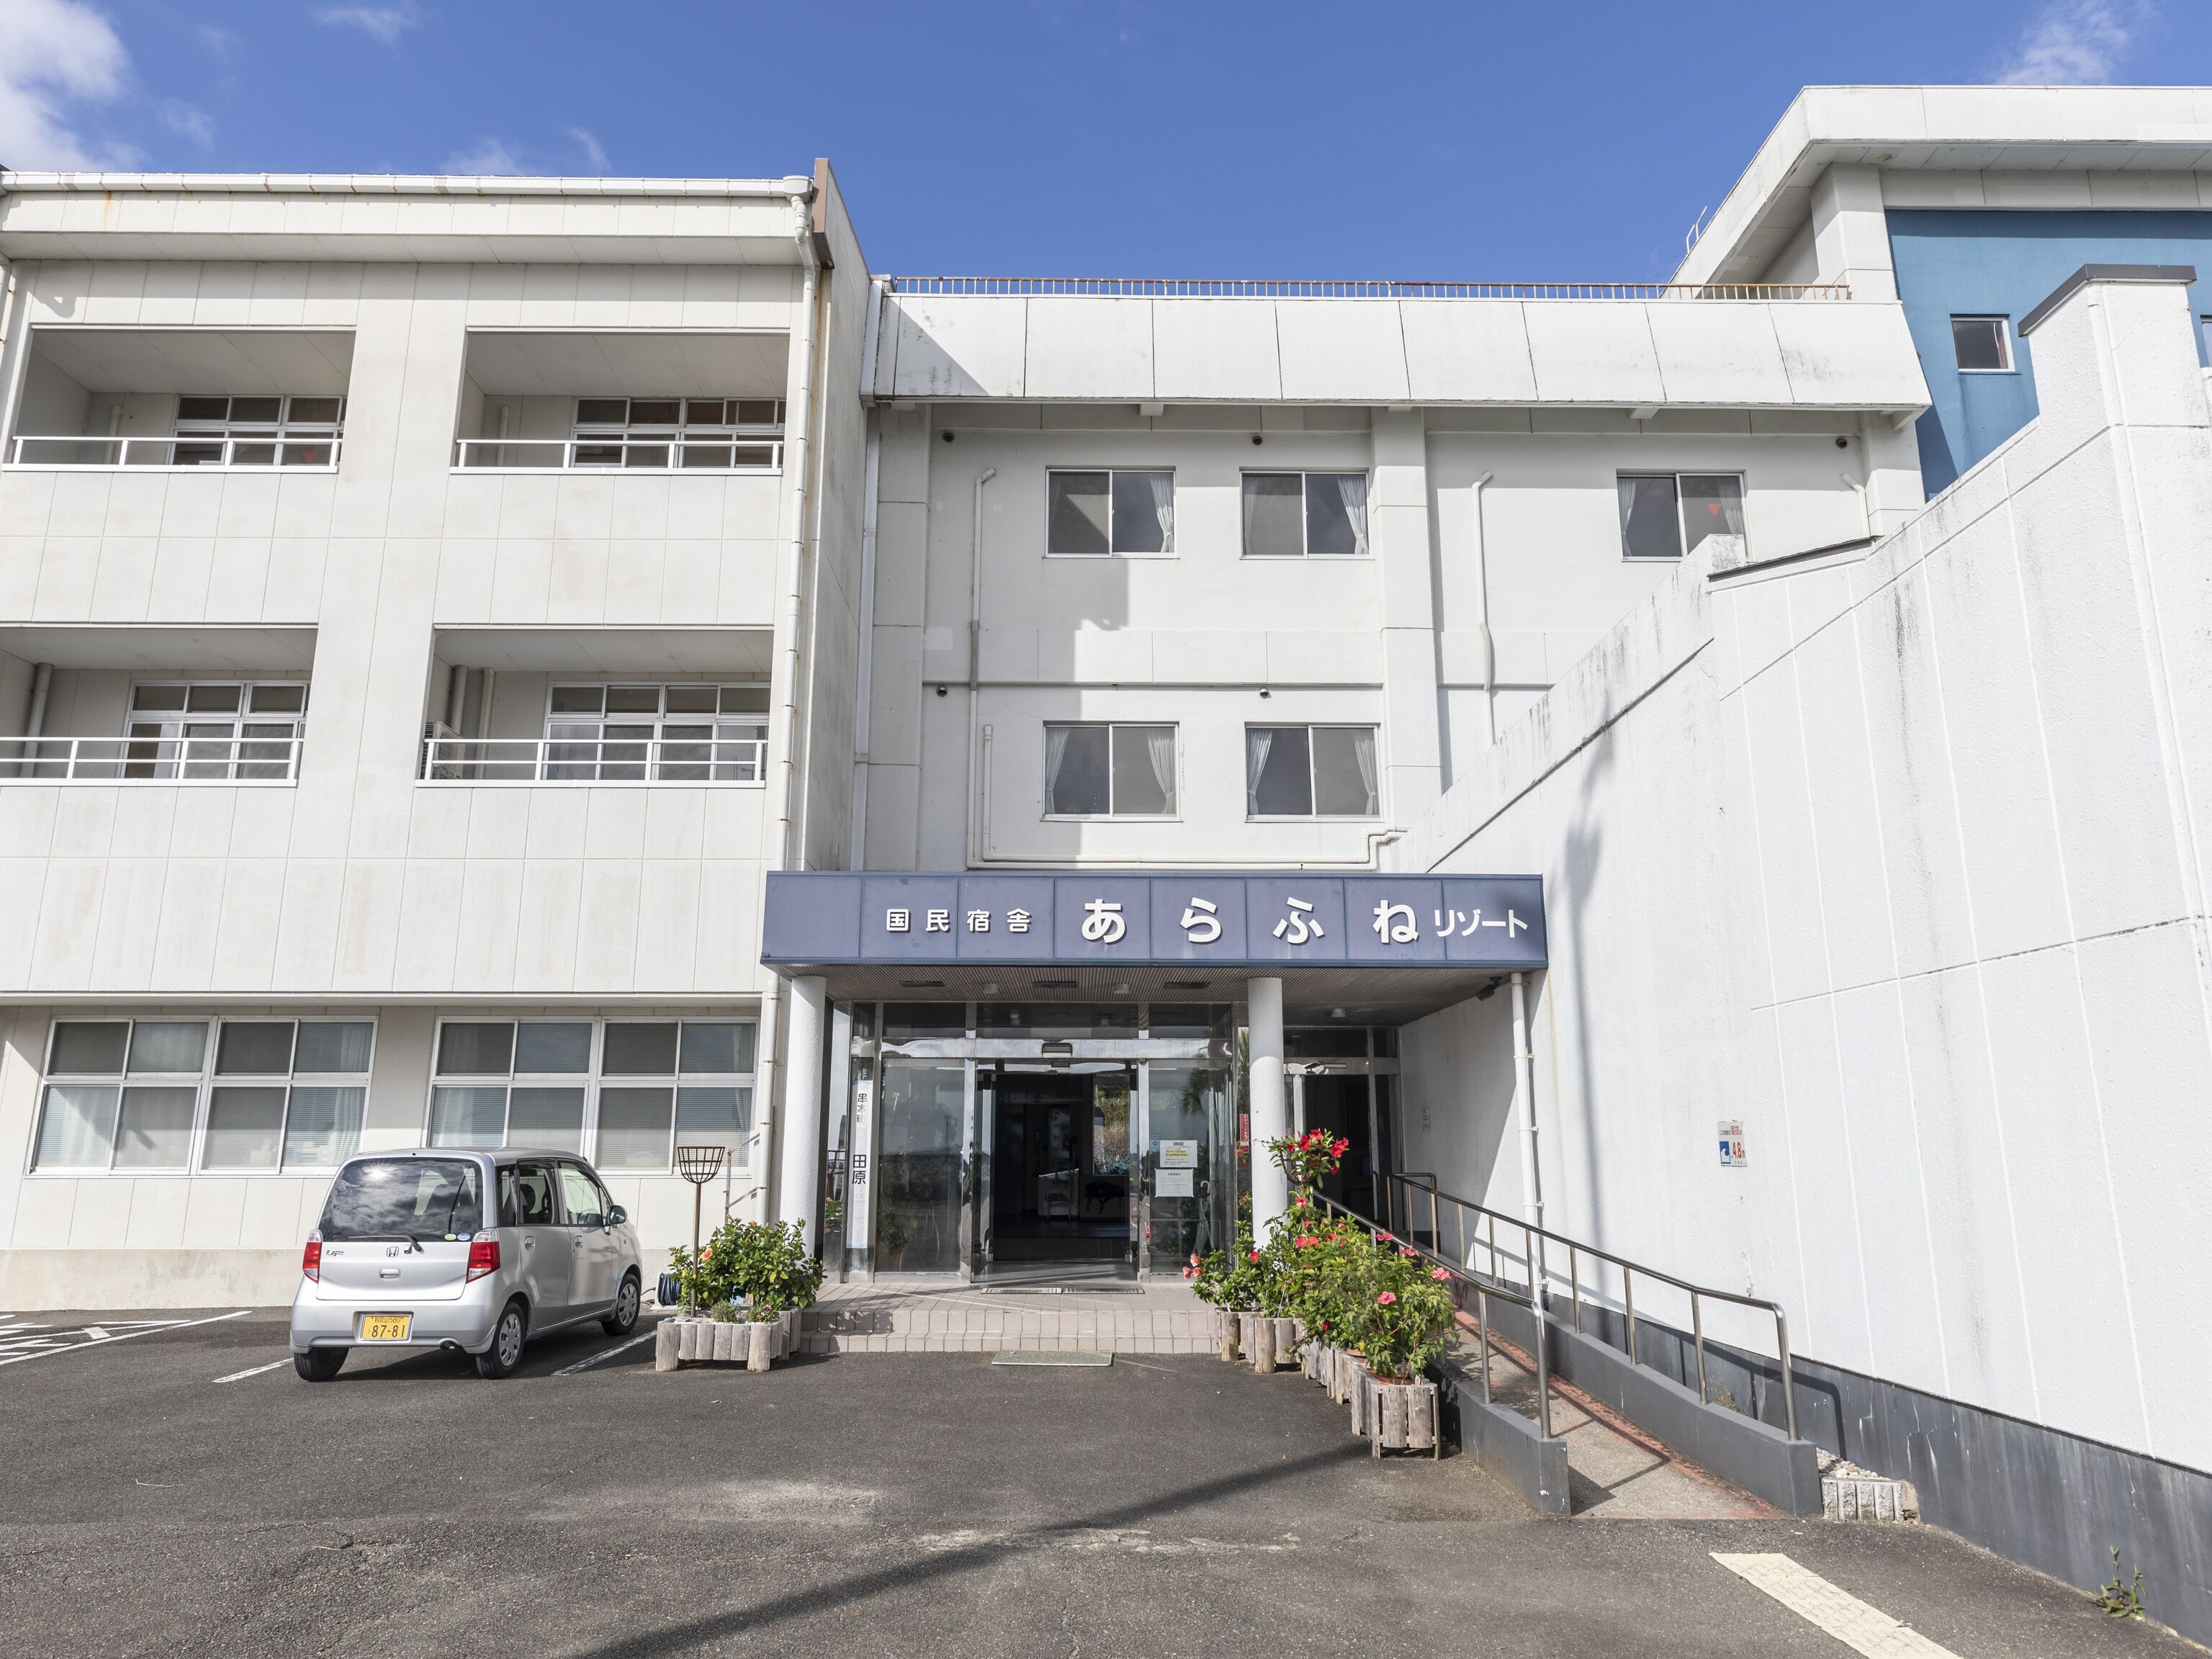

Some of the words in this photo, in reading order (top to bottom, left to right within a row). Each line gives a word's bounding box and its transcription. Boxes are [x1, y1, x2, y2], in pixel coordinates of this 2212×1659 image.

[886, 908, 1030, 932] 国民宿舎
[1081, 896, 1419, 944] あらふね
[1434, 909, 1528, 938] リゾート
[852, 1154, 867, 1184] 田原
[372, 1325, 405, 1337] 87-81
